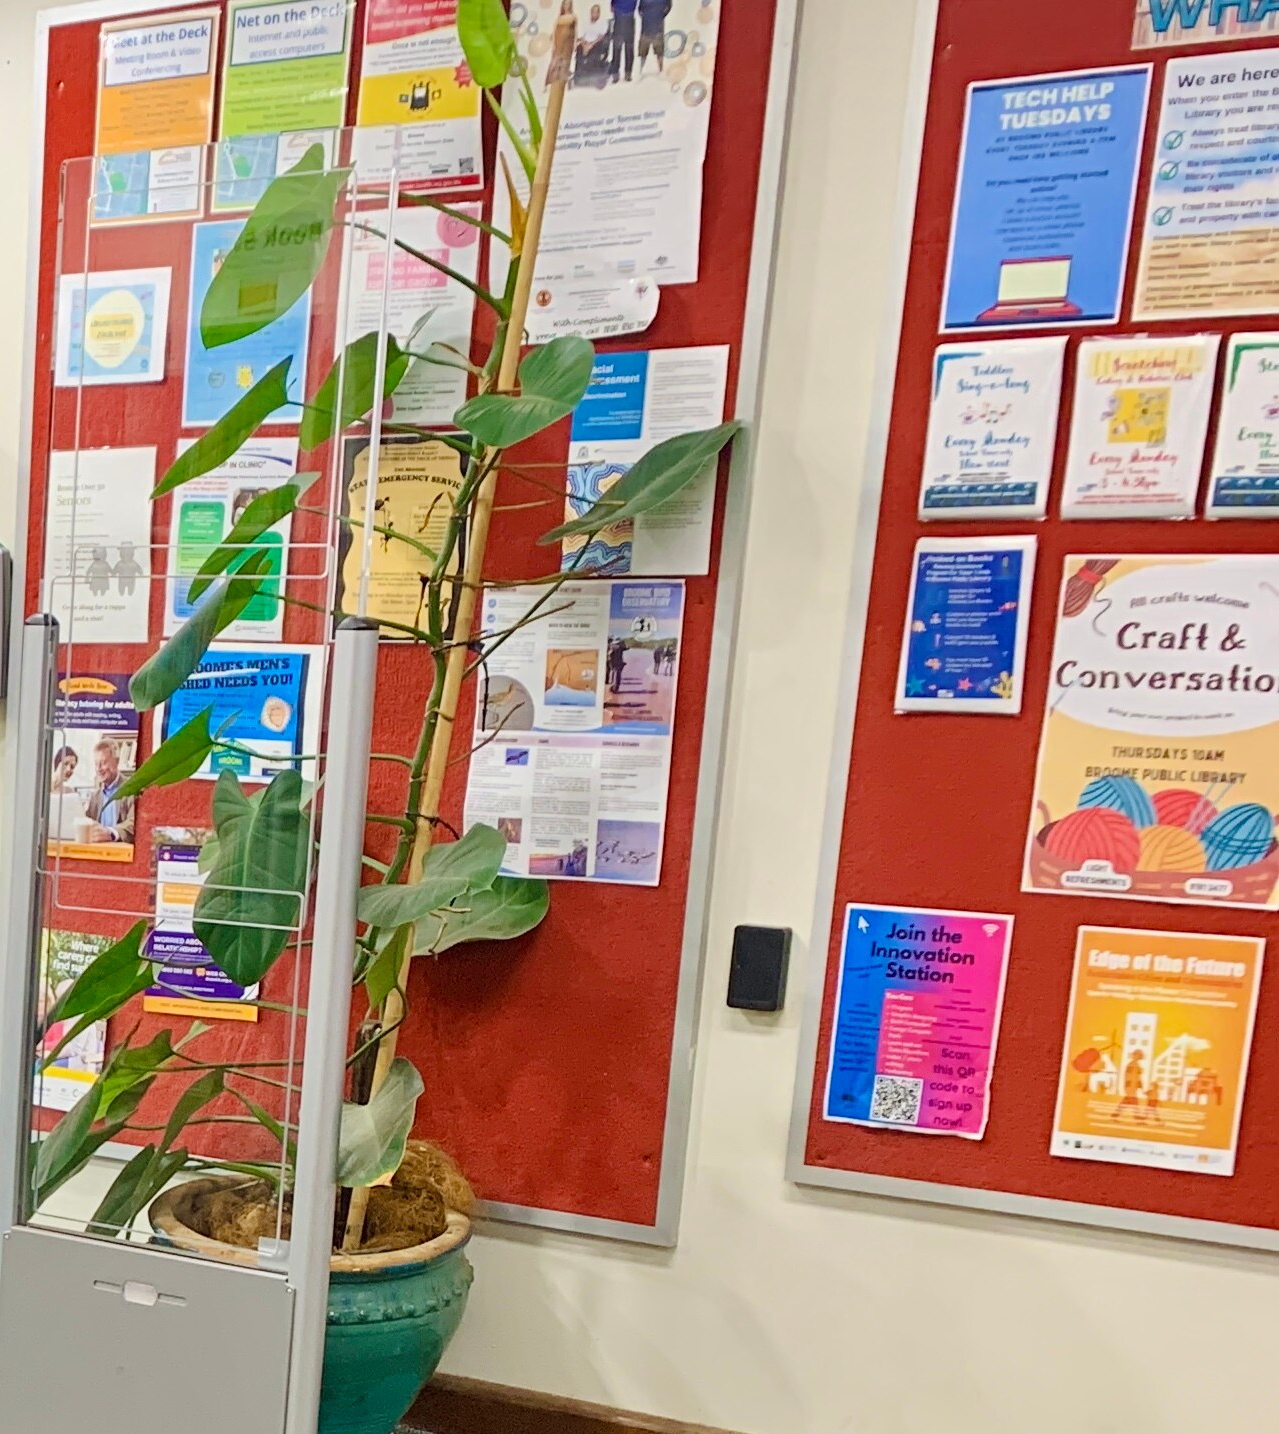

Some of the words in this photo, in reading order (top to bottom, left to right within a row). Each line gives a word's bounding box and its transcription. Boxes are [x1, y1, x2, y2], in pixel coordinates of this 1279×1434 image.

[237, 16, 261, 29] Net
[263, 13, 280, 25] on
[284, 8, 306, 23] the
[113, 38, 138, 49] eet
[142, 34, 153, 44] at
[156, 30, 175, 44] the
[179, 25, 208, 40] Deck
[248, 31, 282, 43] Internet
[284, 29, 301, 40] and
[249, 47, 277, 59] access
[279, 42, 326, 57] computers
[1178, 75, 1205, 87] We
[1210, 72, 1236, 85] are
[1242, 68, 1279, 81] here
[1003, 88, 1057, 110] TECH
[1061, 82, 1114, 103] HELP
[1168, 96, 1197, 105] When
[1201, 94, 1219, 104] you
[1222, 91, 1248, 100] enter
[1253, 87, 1269, 98] the
[1000, 104, 1111, 130] TUESDAYS
[1184, 109, 1221, 119] Library
[1225, 106, 1244, 116] you
[1247, 104, 1264, 113] are
[564, 117, 608, 130] Aboriginal
[1150, 592, 1190, 605] crafts
[1193, 594, 1249, 609] welcome
[1117, 621, 1208, 651] Craft
[1221, 623, 1247, 652] &
[215, 675, 257, 688] NEEDS
[261, 674, 293, 686] YOU!
[1056, 661, 1279, 693] Conversatio
[1112, 746, 1187, 760] THURSDAYS
[1193, 749, 1225, 761] 10AM
[1085, 766, 1138, 779] BROOME
[1142, 770, 1187, 782] PUBLIC
[1191, 771, 1247, 784] LIBRARY
[886, 923, 926, 941] Join
[931, 926, 962, 944] the
[71, 941, 99, 953] Where
[871, 941, 975, 965] Innovation
[53, 959, 70, 970] find
[1088, 949, 1131, 970] Edge
[1132, 953, 1153, 970] of
[1153, 955, 1184, 973] the
[1186, 957, 1246, 977] Future
[885, 962, 955, 984] Station
[941, 1048, 971, 1061] Scan
[933, 1064, 954, 1076] this
[929, 1080, 959, 1092] code
[963, 1084, 975, 1095] to
[928, 1097, 952, 1110] sign
[956, 1102, 972, 1113] up
